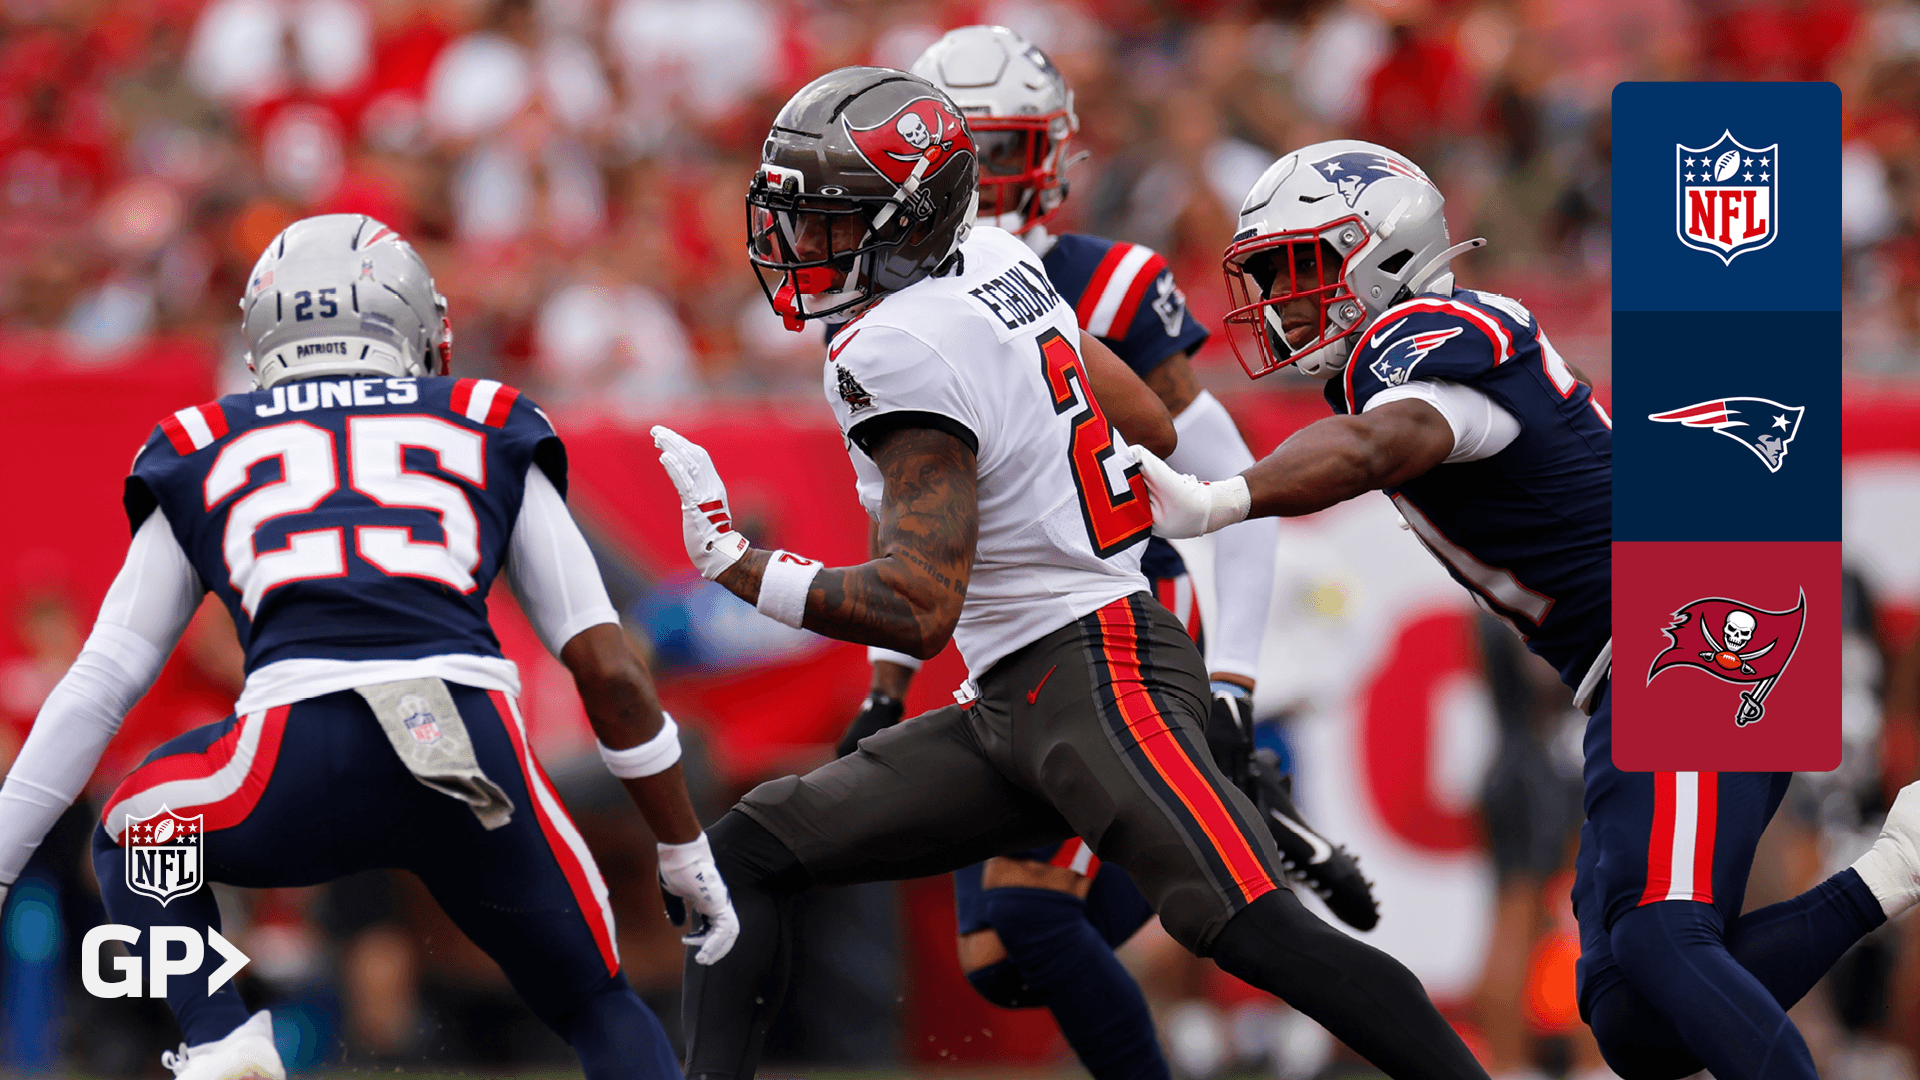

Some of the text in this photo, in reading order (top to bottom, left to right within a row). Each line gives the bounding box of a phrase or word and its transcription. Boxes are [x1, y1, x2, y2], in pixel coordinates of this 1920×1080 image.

[294, 287, 338, 322] 25
[968, 260, 1060, 330] EGBUKA
[296, 341, 347, 359] PATRIOTS
[255, 377, 418, 418] JONES
[1035, 326, 1153, 560] 2
[202, 413, 487, 624] 25
